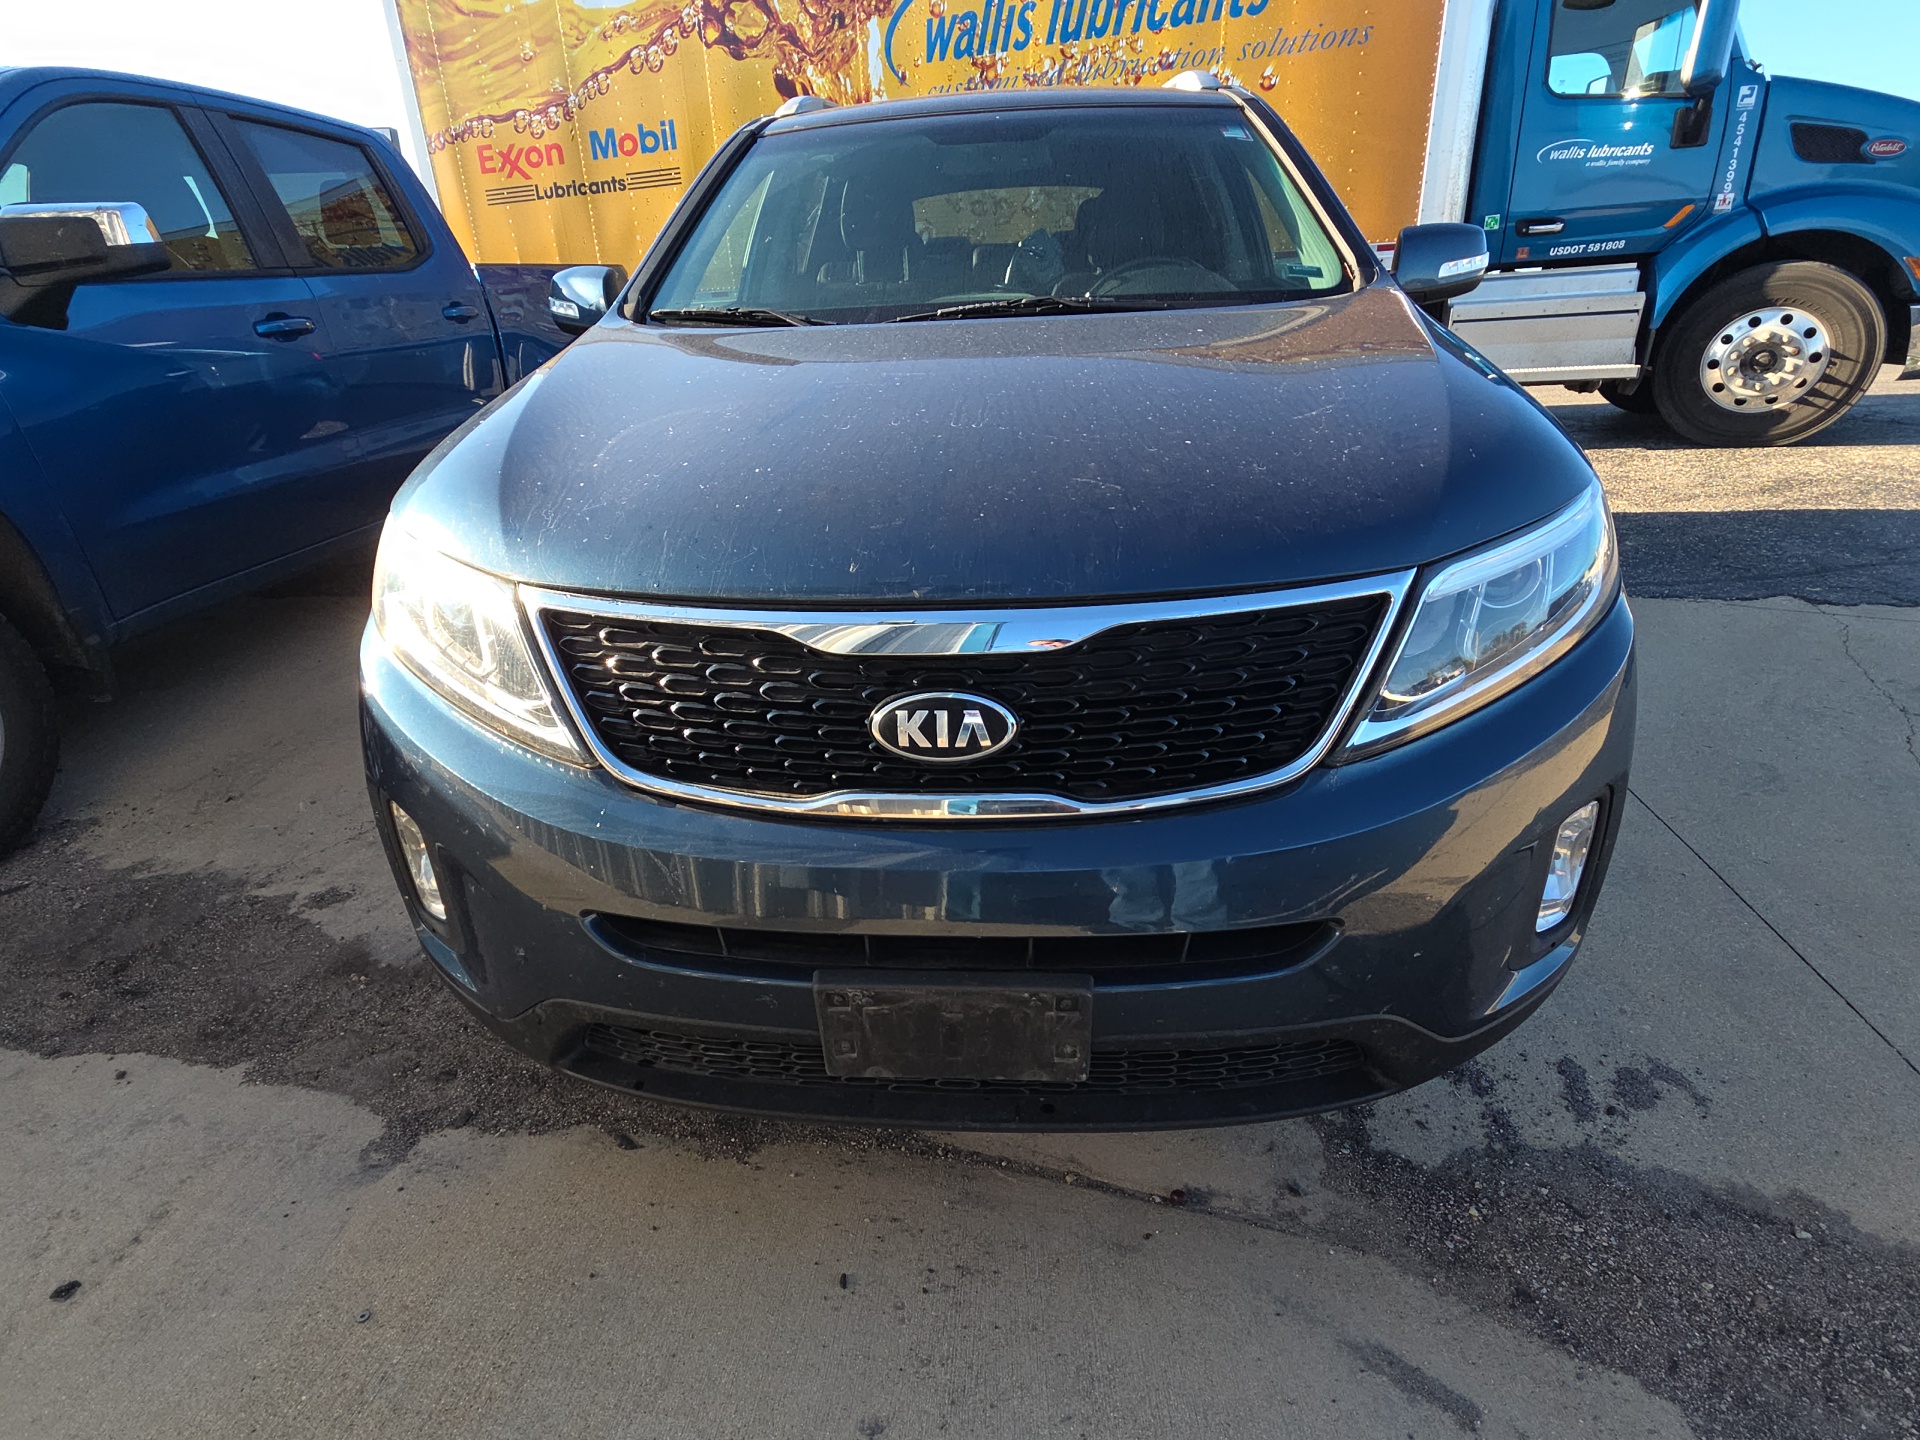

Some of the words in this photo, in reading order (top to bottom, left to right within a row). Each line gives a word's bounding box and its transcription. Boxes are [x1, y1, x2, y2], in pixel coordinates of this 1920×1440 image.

[926, 0, 1037, 63] wallis
[1073, 42, 1225, 83] lubrication
[1236, 23, 1375, 61] solutions
[477, 142, 565, 180] Exxon
[588, 119, 678, 161] Mobil
[1549, 146, 1587, 160] wallis
[1586, 142, 1655, 158] lubricants
[1723, 111, 1748, 193] 4541399
[534, 176, 627, 200] Lubricants
[1549, 244, 1586, 256] USDOT
[1587, 240, 1626, 253] 581808
[895, 710, 992, 748] KIA
